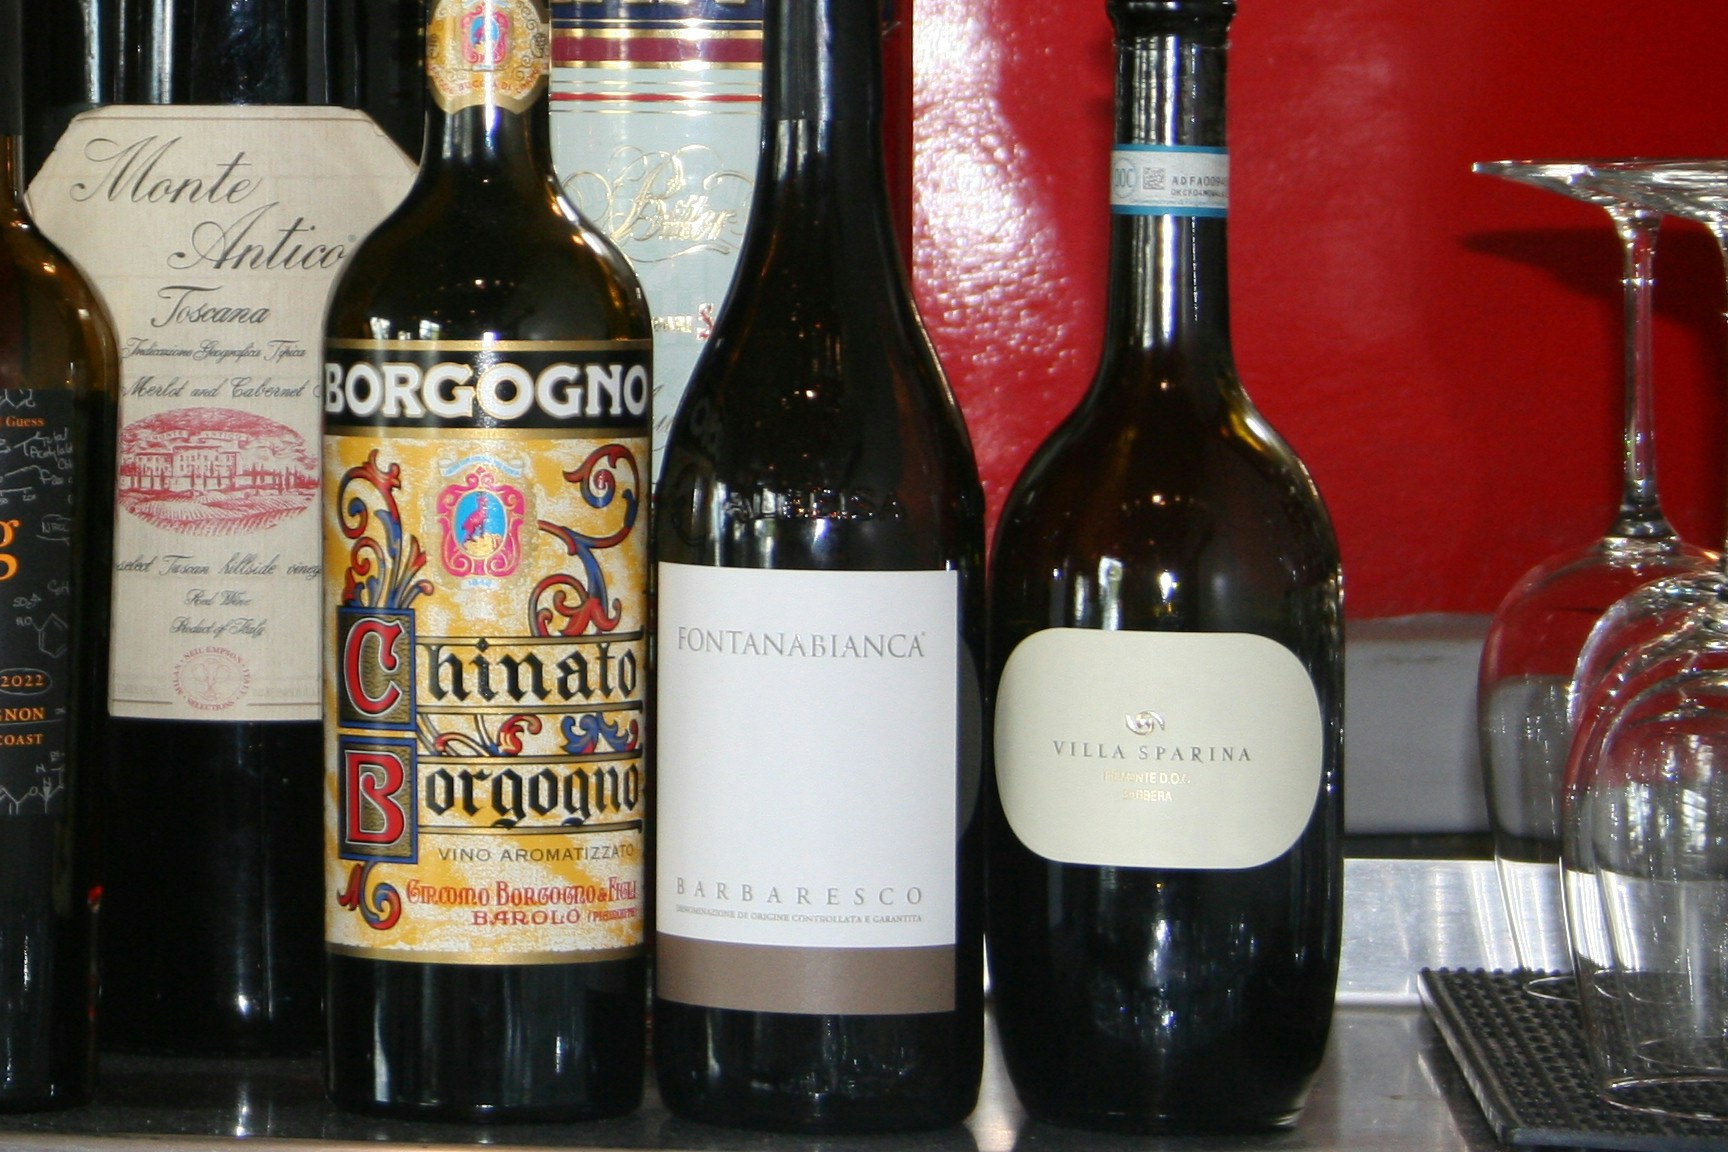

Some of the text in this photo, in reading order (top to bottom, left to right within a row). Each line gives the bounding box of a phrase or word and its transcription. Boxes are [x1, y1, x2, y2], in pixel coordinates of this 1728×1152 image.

[71, 135, 264, 204] Monte
[167, 201, 346, 270] Antico
[151, 285, 271, 328] Toscana
[125, 375, 189, 398] Merlot
[190, 377, 227, 397] and
[230, 376, 309, 398] Cabernet
[325, 362, 648, 420] BORGOGNO
[5, 416, 45, 428] Guess
[159, 554, 211, 576] Tuscan
[217, 552, 280, 575] hillside
[184, 588, 252, 606] Red Wine
[169, 616, 267, 639] Product of Italy
[677, 626, 925, 659] FONTANABIANCA
[344, 618, 637, 716] Chinato
[0, 675, 44, 687] 2022
[1052, 740, 1252, 764] VILLA SPARINA
[345, 750, 638, 845] Borgogno
[438, 843, 634, 861] VINO AROMATIZZATO
[676, 877, 923, 905] BARBARESCO
[472, 909, 580, 925] BAROLO
[675, 904, 922, 924] DENOMINAZIONE DI ORIGINE CONTROLLATA E GARANTITA
